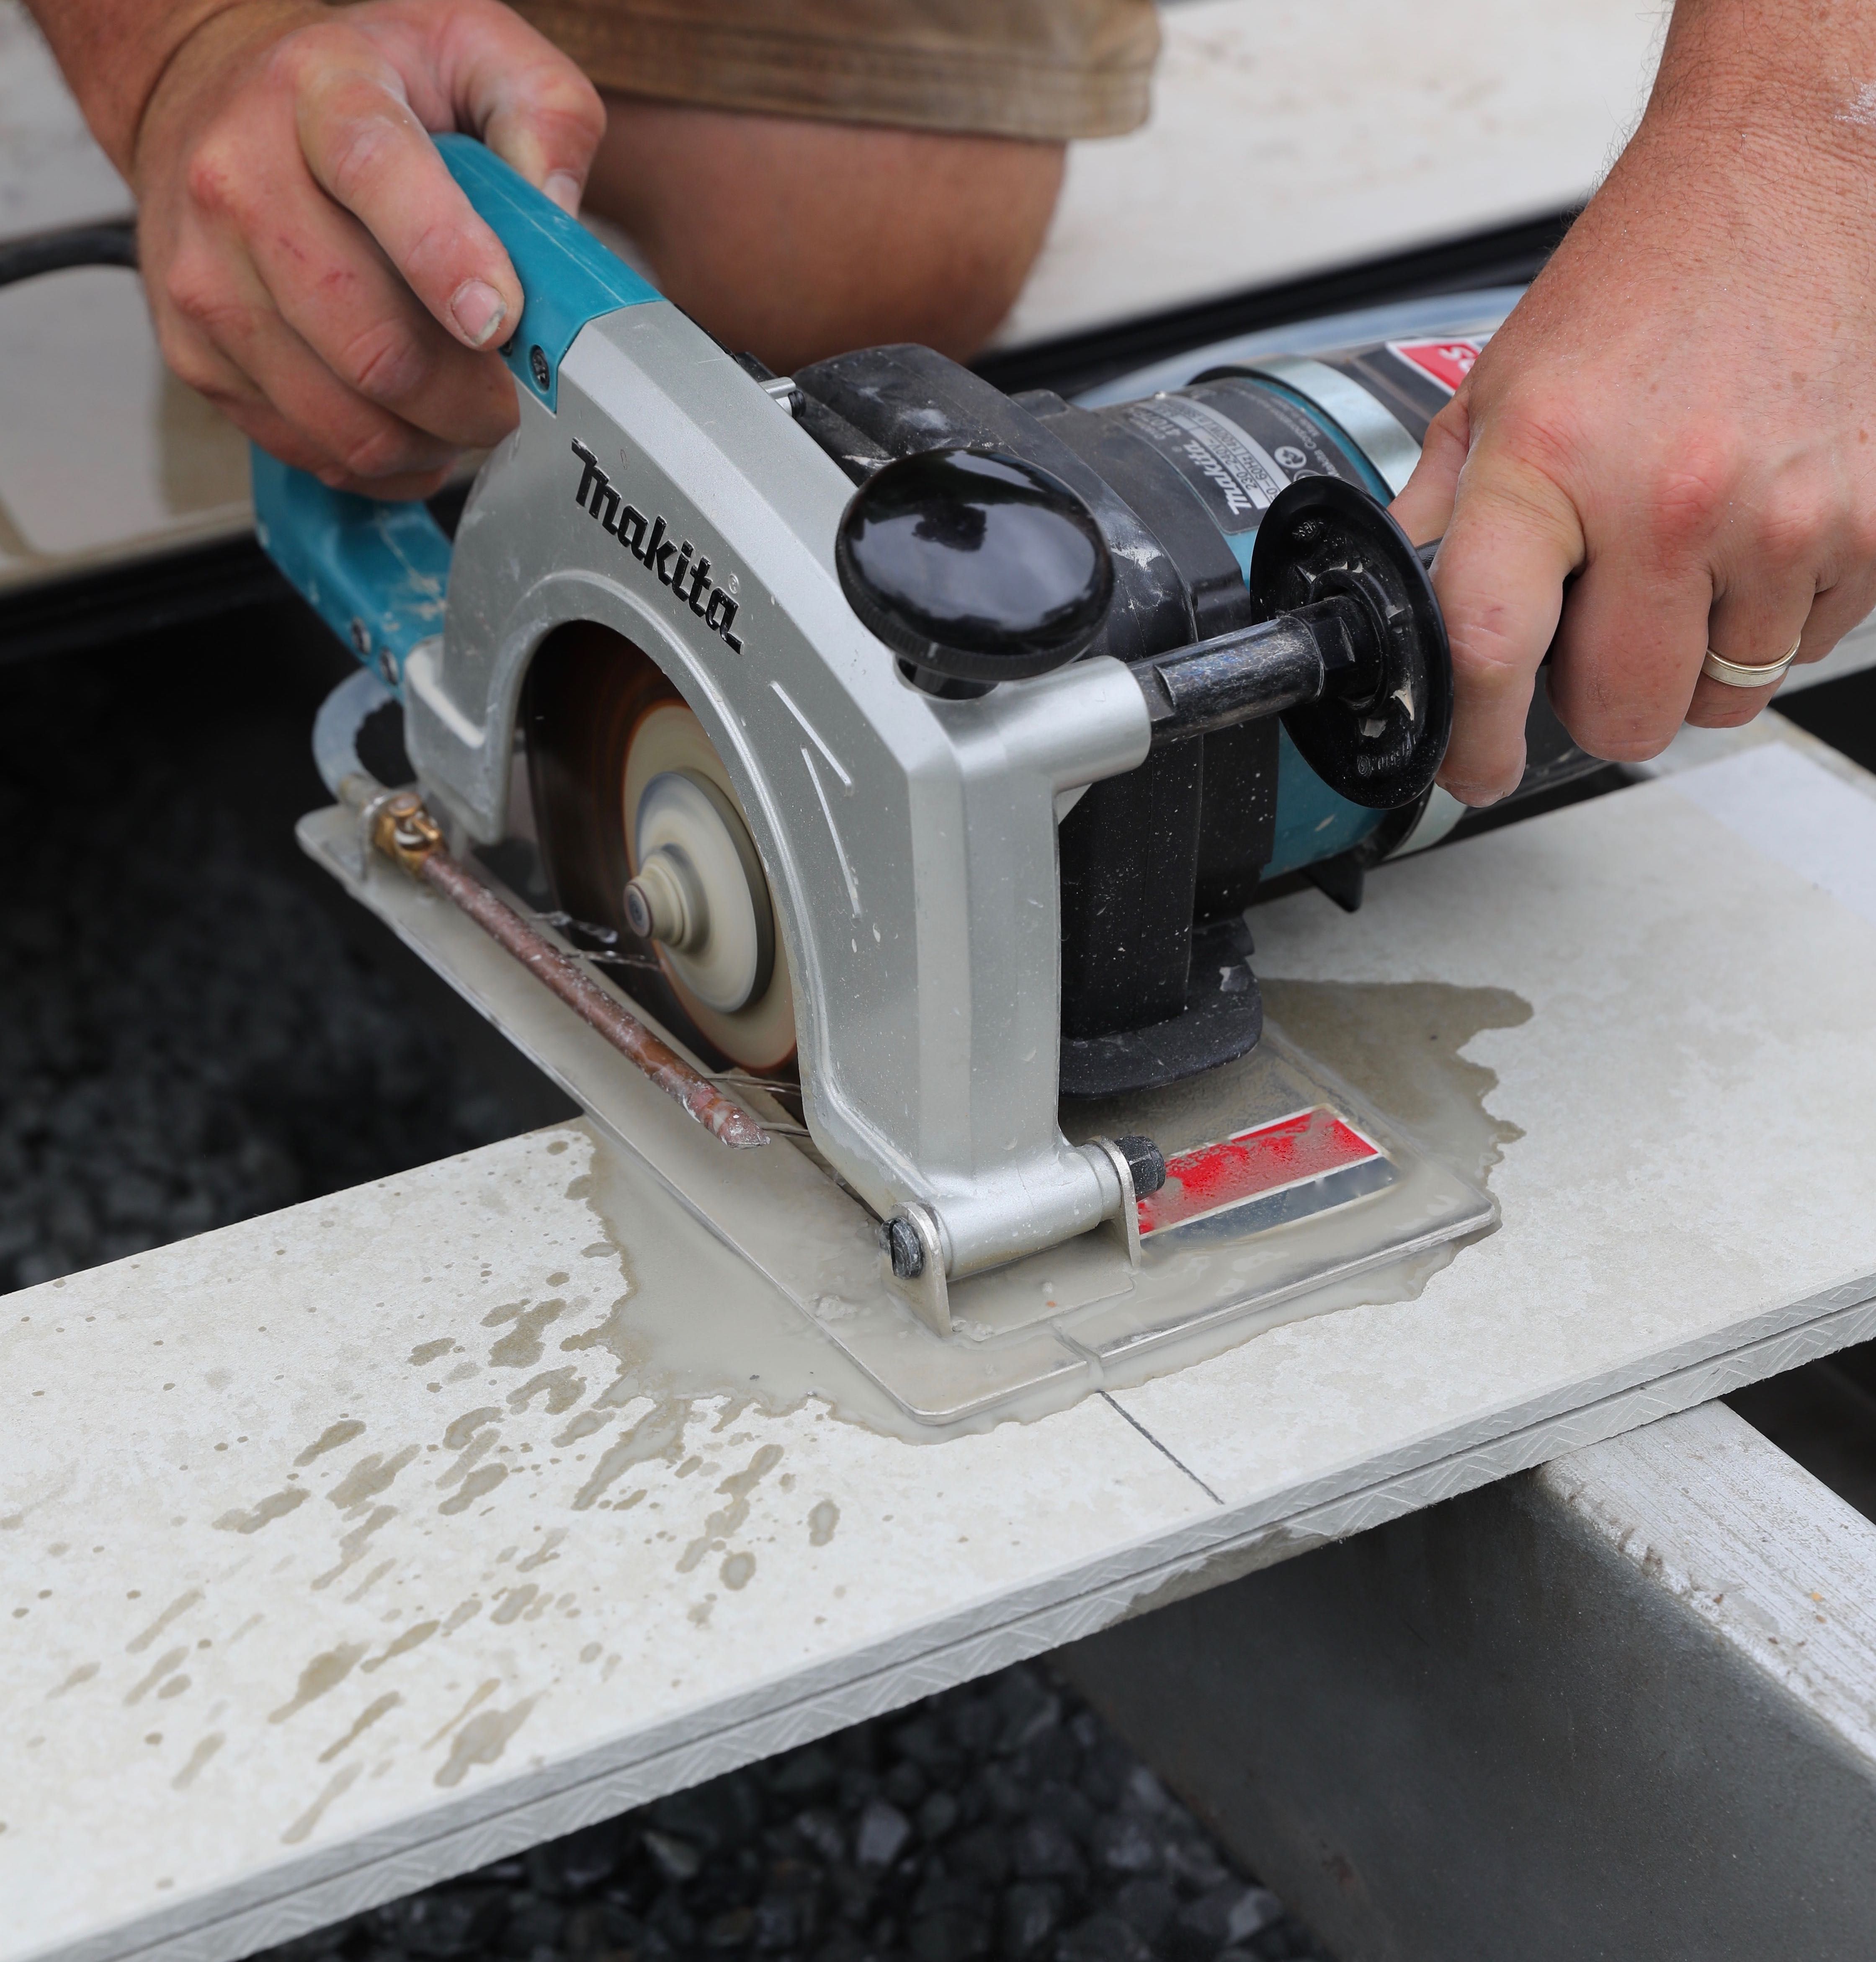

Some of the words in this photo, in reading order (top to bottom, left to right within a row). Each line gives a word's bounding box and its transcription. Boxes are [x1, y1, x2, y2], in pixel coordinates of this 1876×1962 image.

[1209, 423, 1240, 453] 1400W
[1183, 439, 1252, 515] Makita
[571, 437, 745, 656] Makita
